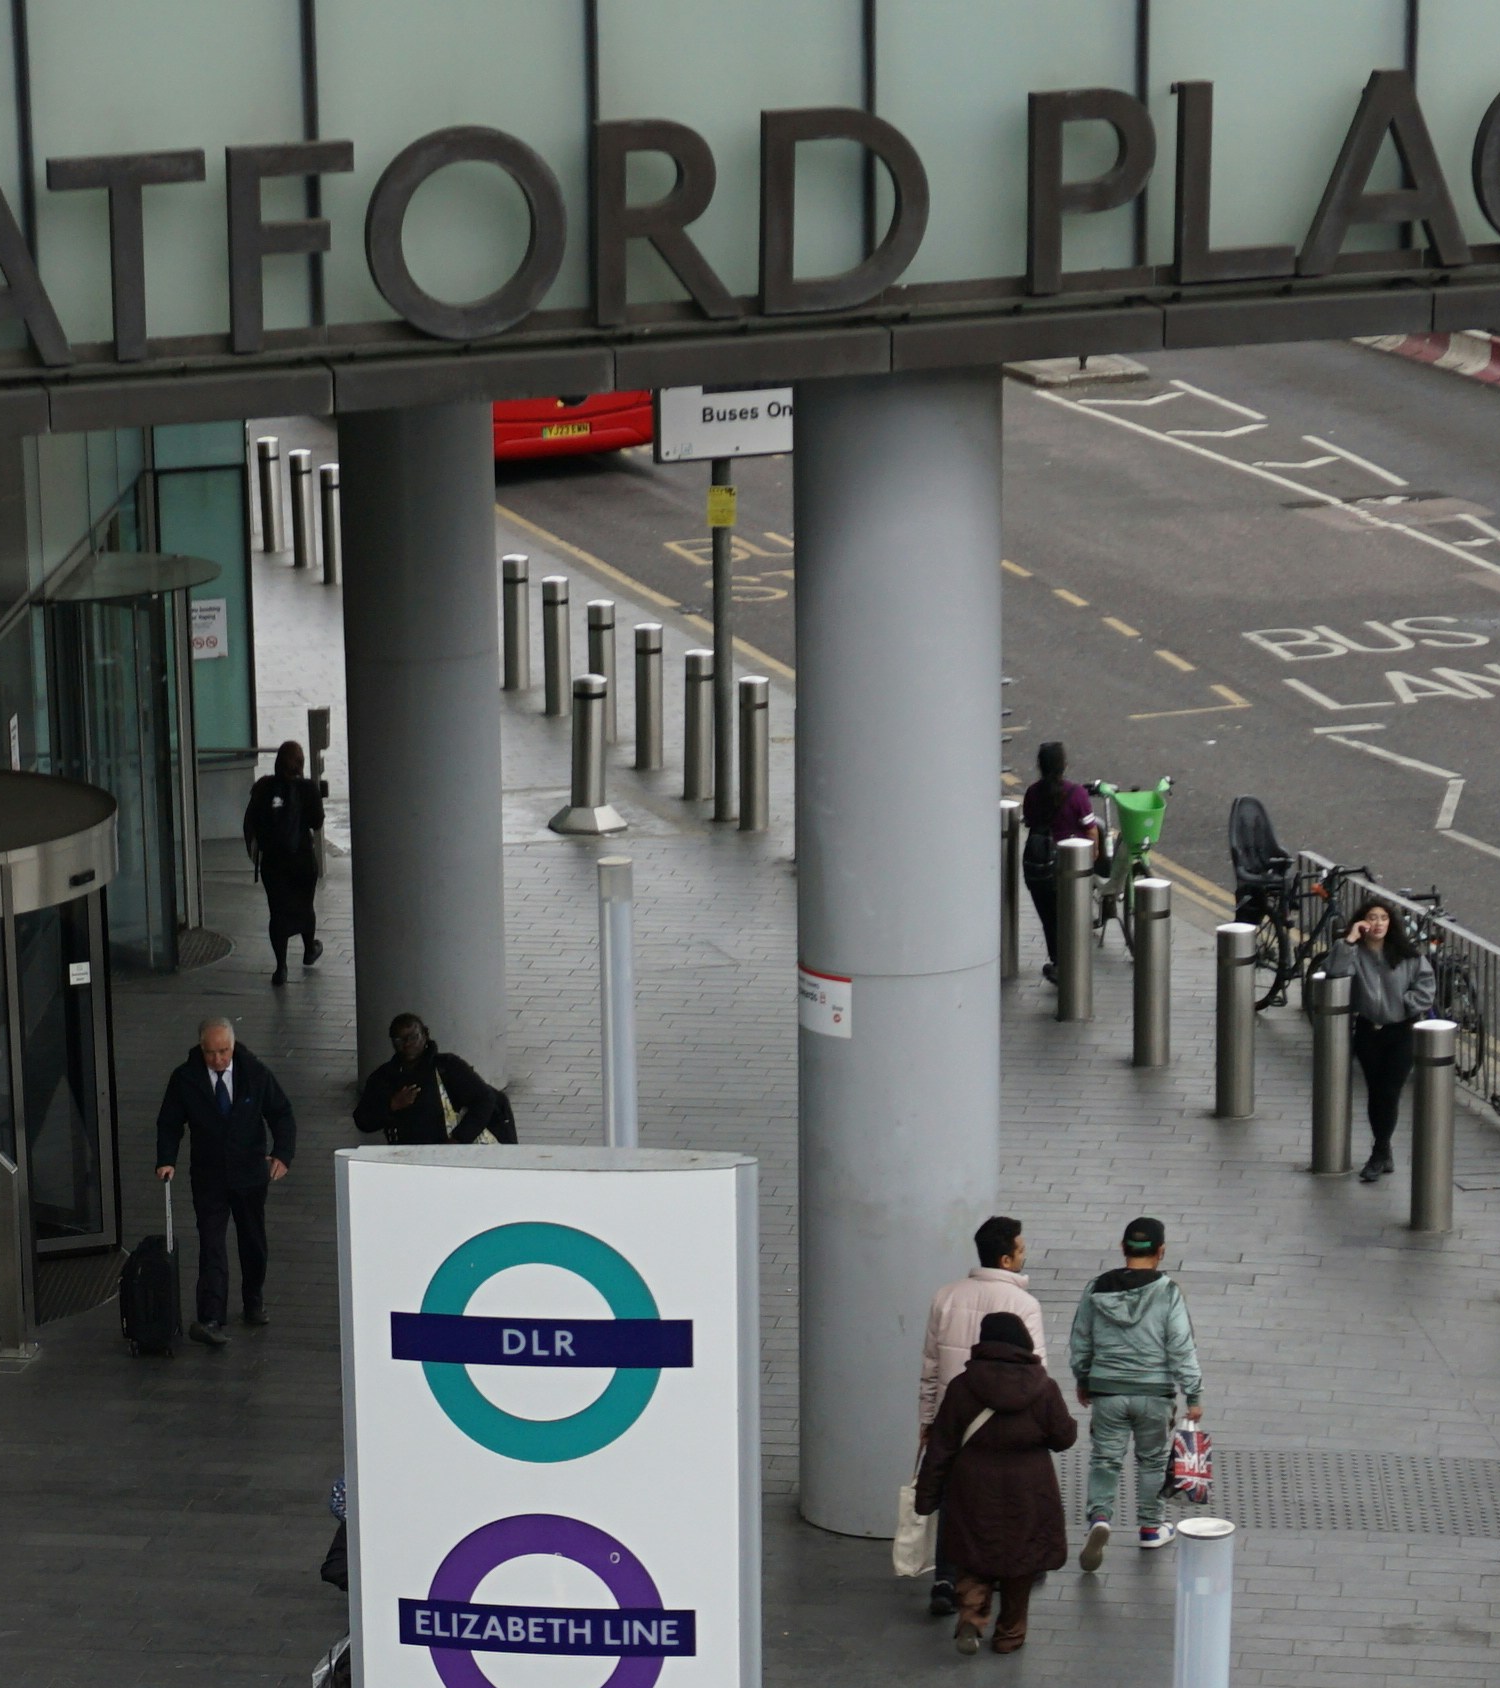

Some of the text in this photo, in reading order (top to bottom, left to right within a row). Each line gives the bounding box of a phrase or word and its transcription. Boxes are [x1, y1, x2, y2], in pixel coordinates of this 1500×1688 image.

[702, 405, 759, 423] Buses
[1242, 616, 1490, 661] BUS
[501, 1329, 577, 1359] DLR
[414, 1609, 681, 1647] ELIZABETH LINE
